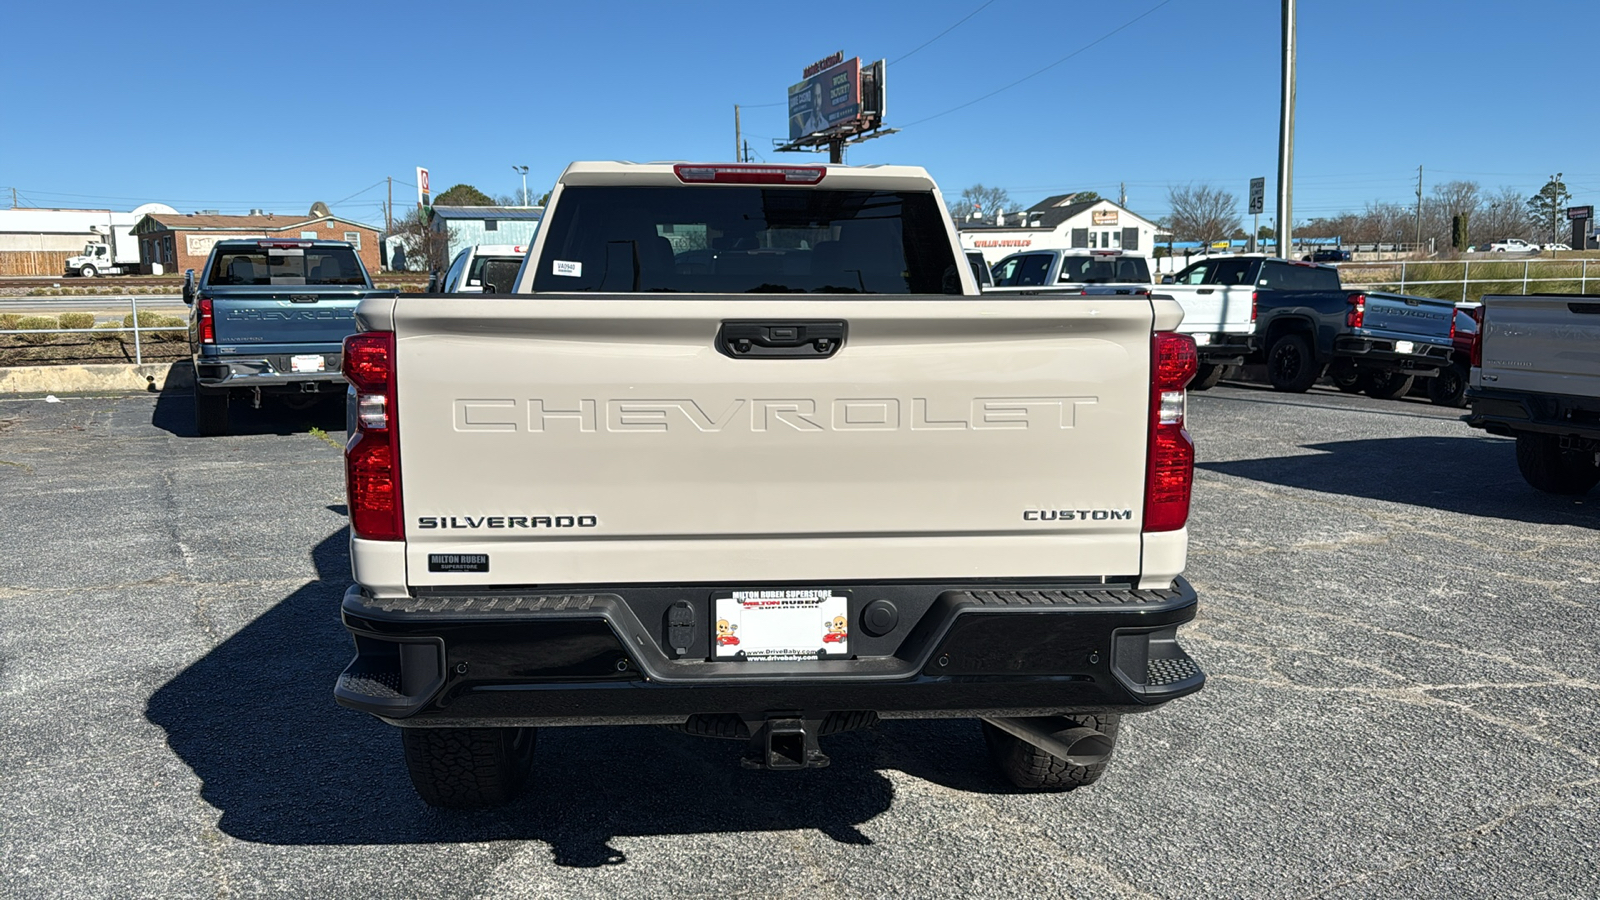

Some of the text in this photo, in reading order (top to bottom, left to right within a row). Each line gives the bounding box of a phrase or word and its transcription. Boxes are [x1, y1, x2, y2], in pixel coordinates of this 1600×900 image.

[1251, 189, 1262, 197] LIMIT
[1250, 197, 1263, 210] 45
[227, 310, 355, 321] CHEVROL
[1371, 305, 1448, 320] CHEVROLET
[453, 397, 1099, 432] CHEVROLET
[1023, 510, 1132, 520] CUSTOM
[418, 516, 597, 529] SILVERADO
[431, 555, 486, 563] MILTON RUBEN
[732, 590, 832, 600] MILTON RUBEN SUPERSTORE
